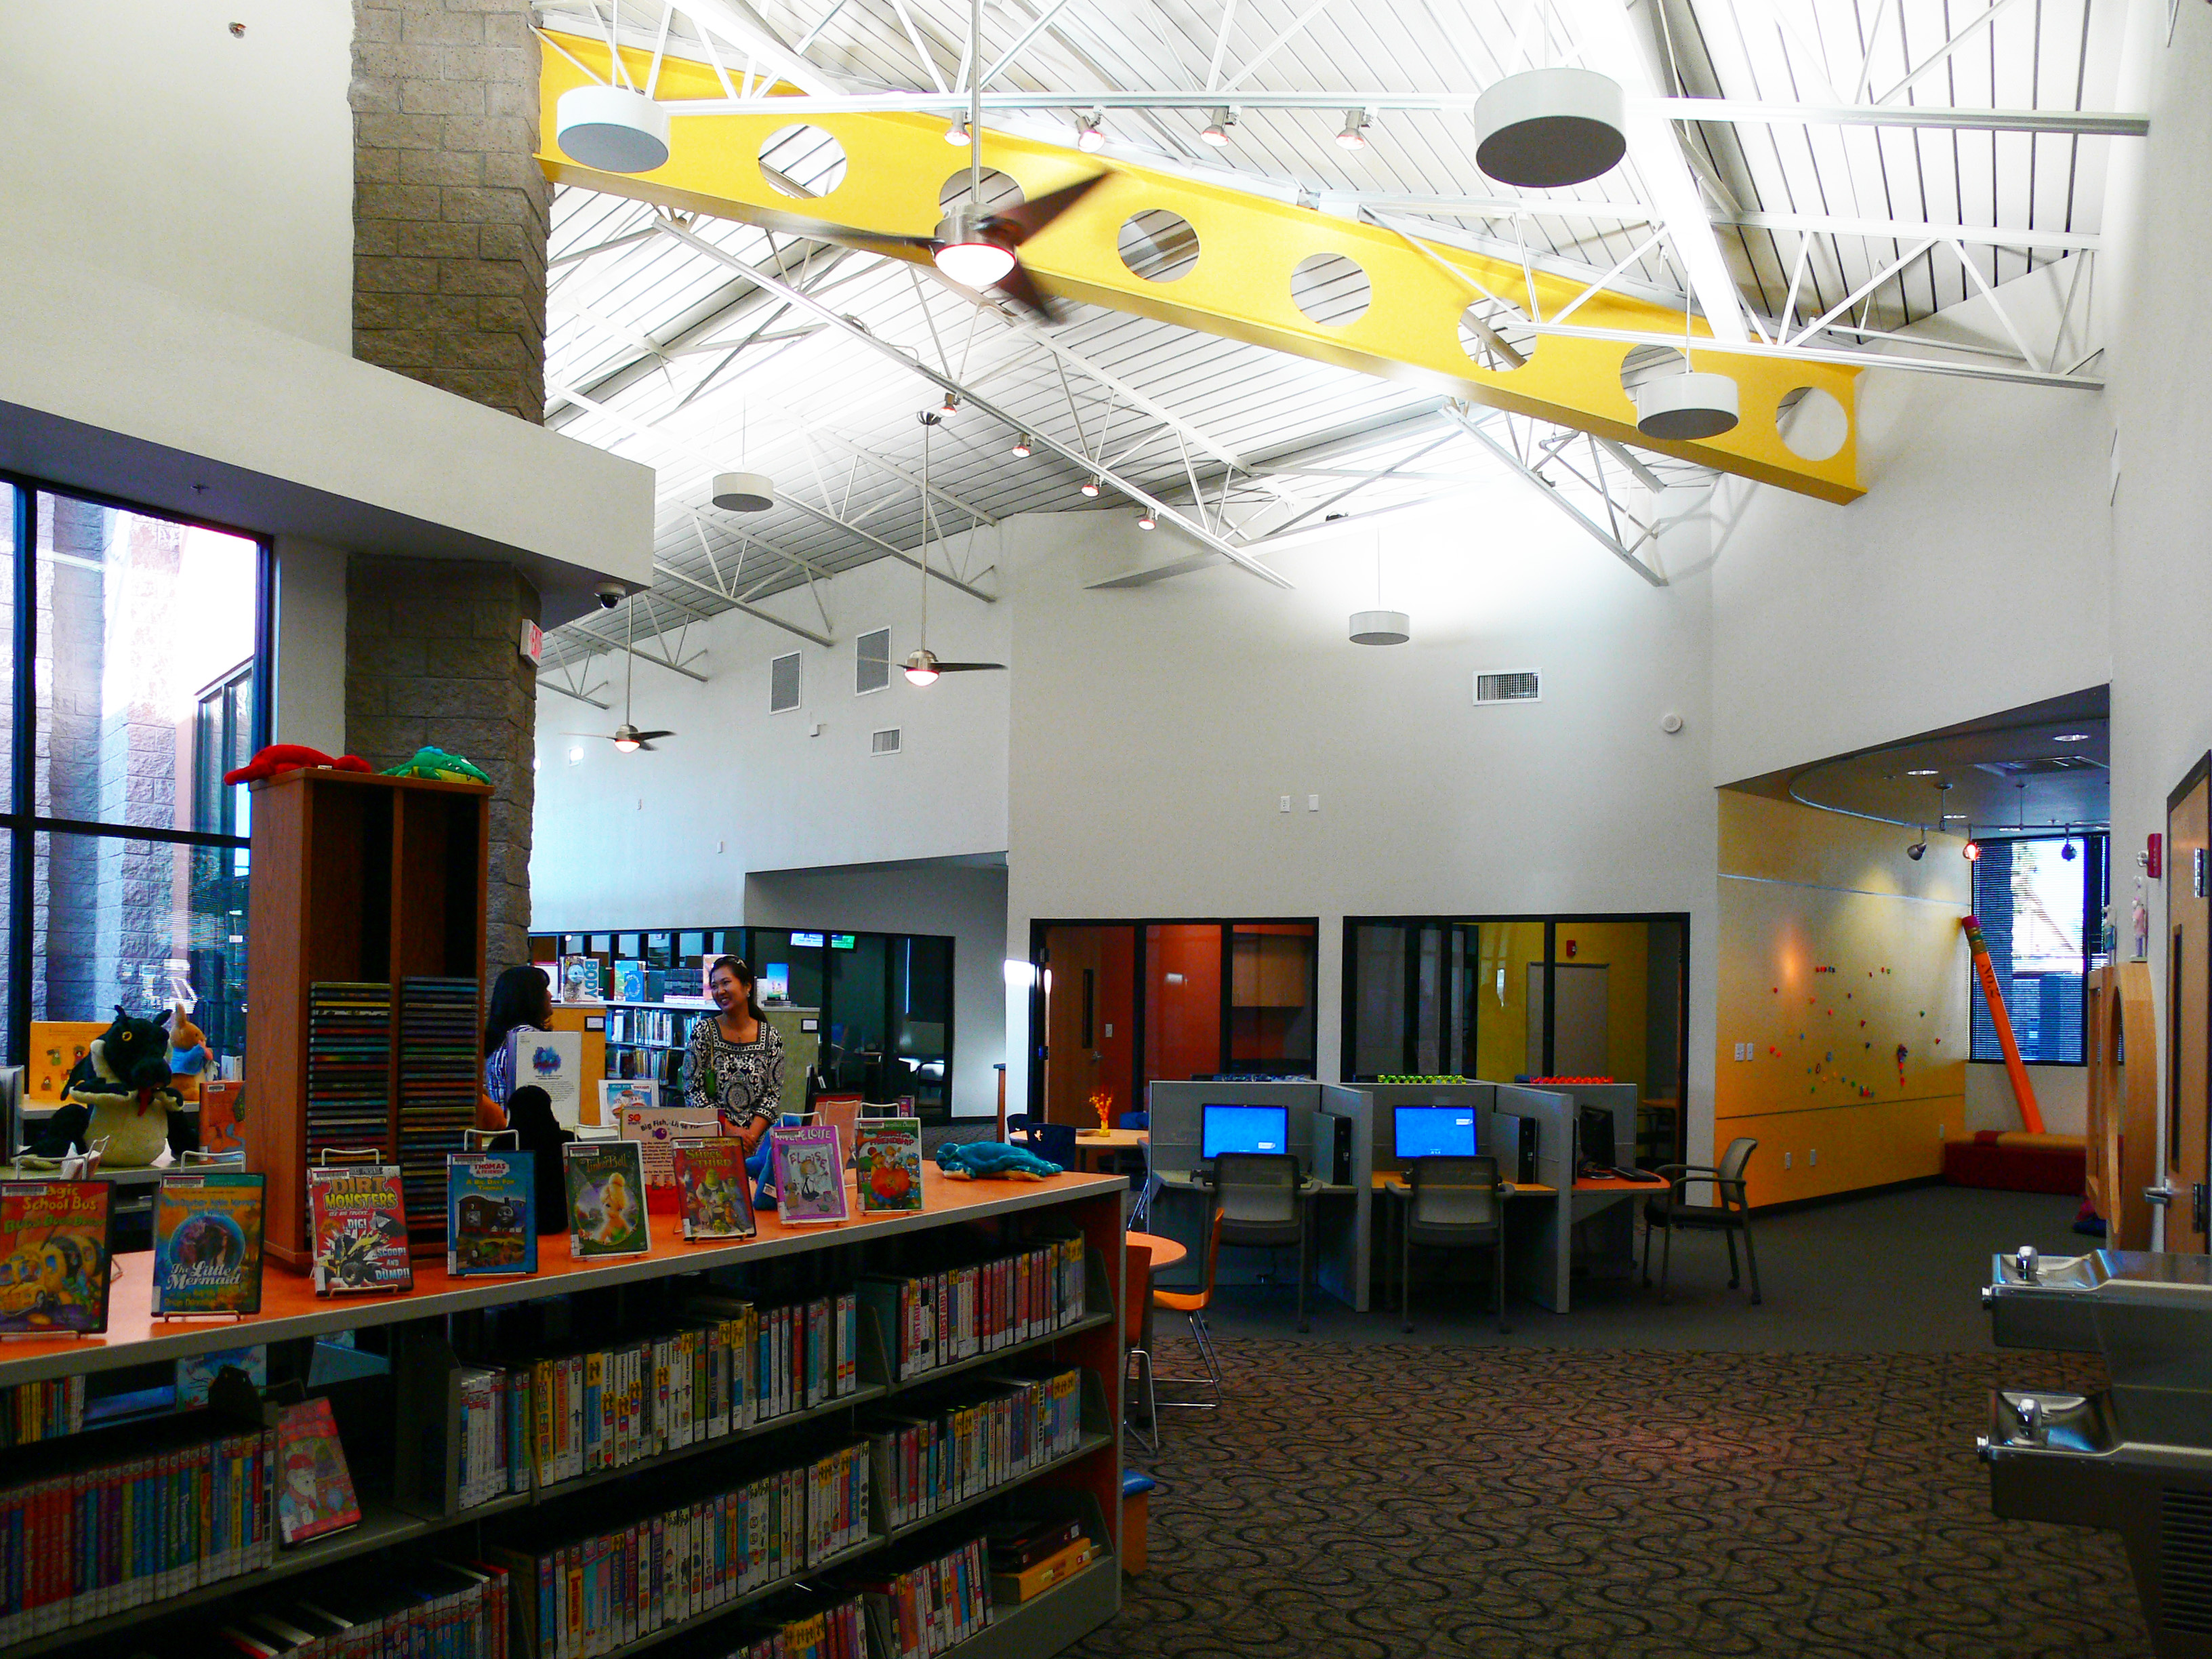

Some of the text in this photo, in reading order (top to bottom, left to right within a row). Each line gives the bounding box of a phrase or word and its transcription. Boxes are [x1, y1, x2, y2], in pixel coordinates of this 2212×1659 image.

[584, 961, 598, 998] BODY
[640, 1124, 652, 1132] Big
[47, 1184, 79, 1199] agic
[331, 1176, 386, 1194] DIRT
[22, 1196, 97, 1210] School Bus
[325, 1193, 397, 1210] MONSTERS
[191, 1261, 232, 1277] Little
[166, 1273, 242, 1290] Mermaid
